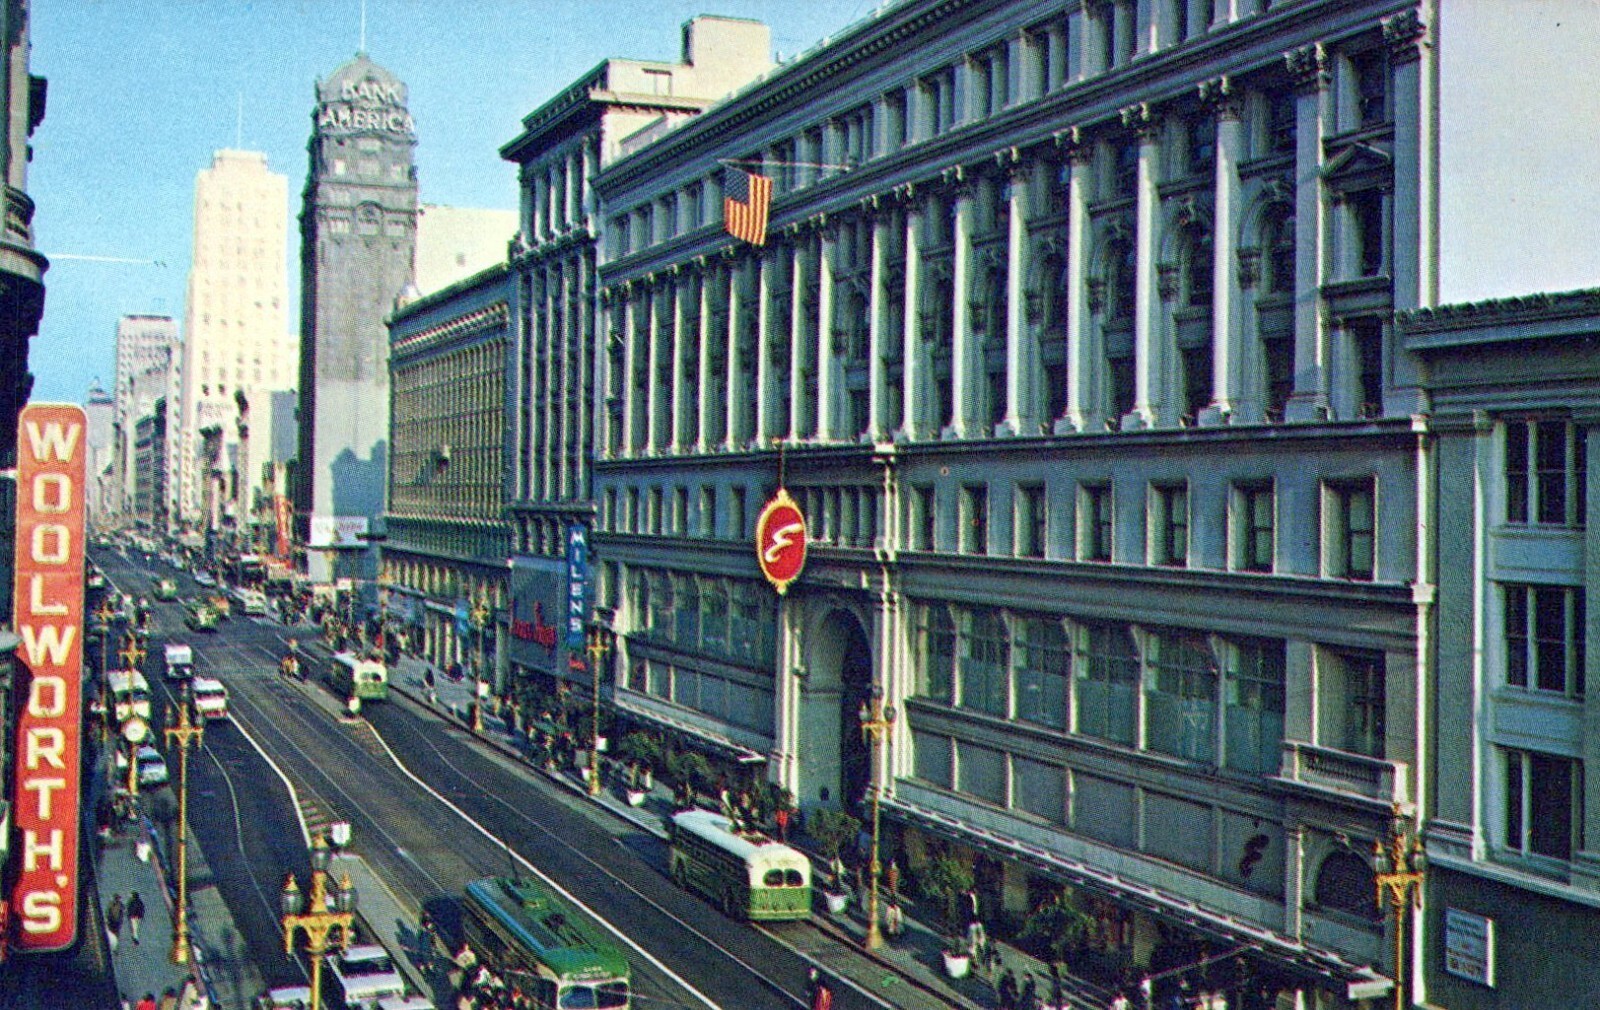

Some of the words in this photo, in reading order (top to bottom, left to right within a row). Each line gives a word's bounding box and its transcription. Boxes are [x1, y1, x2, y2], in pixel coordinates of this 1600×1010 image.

[341, 79, 400, 105] BANK
[319, 105, 415, 132] AMERICA
[569, 530, 586, 632] MILENS
